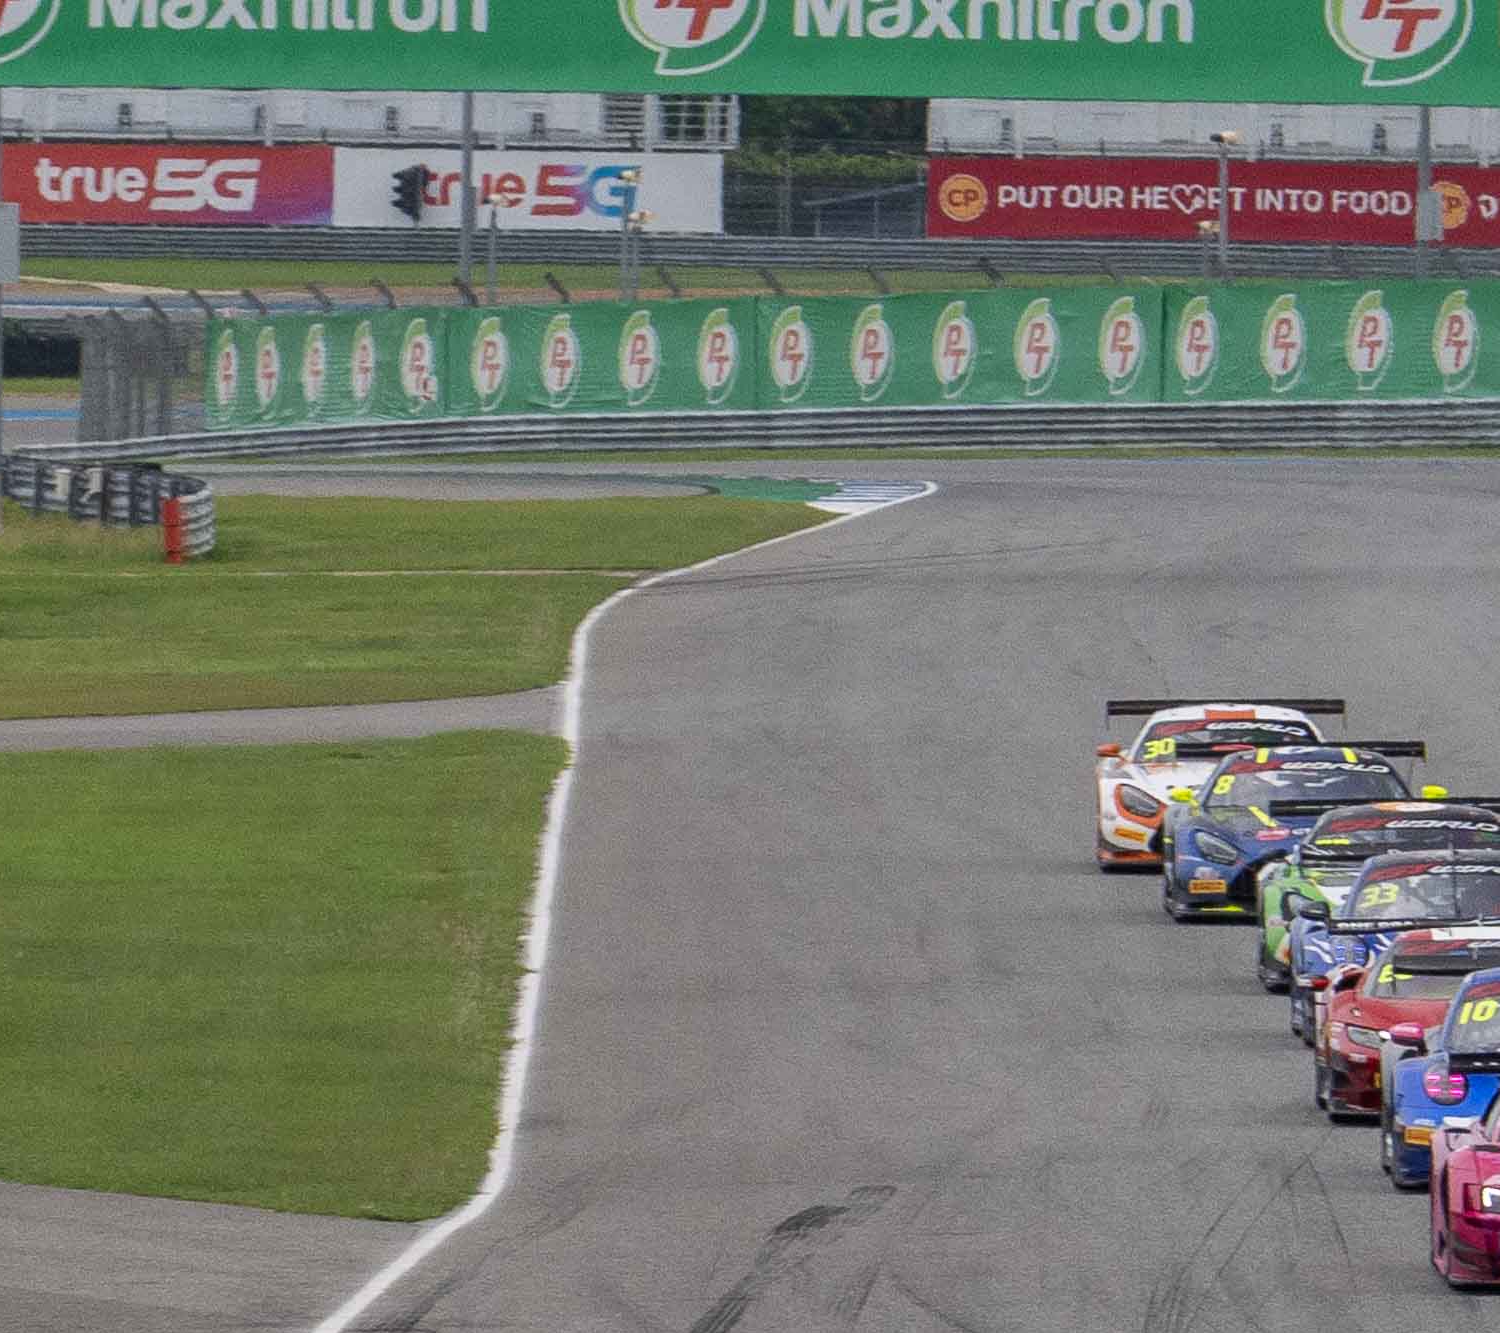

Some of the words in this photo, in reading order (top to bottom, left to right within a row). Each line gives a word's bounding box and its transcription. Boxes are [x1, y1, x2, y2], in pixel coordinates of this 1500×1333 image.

[997, 185, 1056, 209] PUT
[1063, 184, 1125, 210] OUR
[1255, 187, 1325, 213] INTO
[1331, 189, 1413, 216] FOOD
[1143, 738, 1177, 759] 30
[1212, 775, 1235, 795] 8
[1459, 999, 1499, 1025] 10
